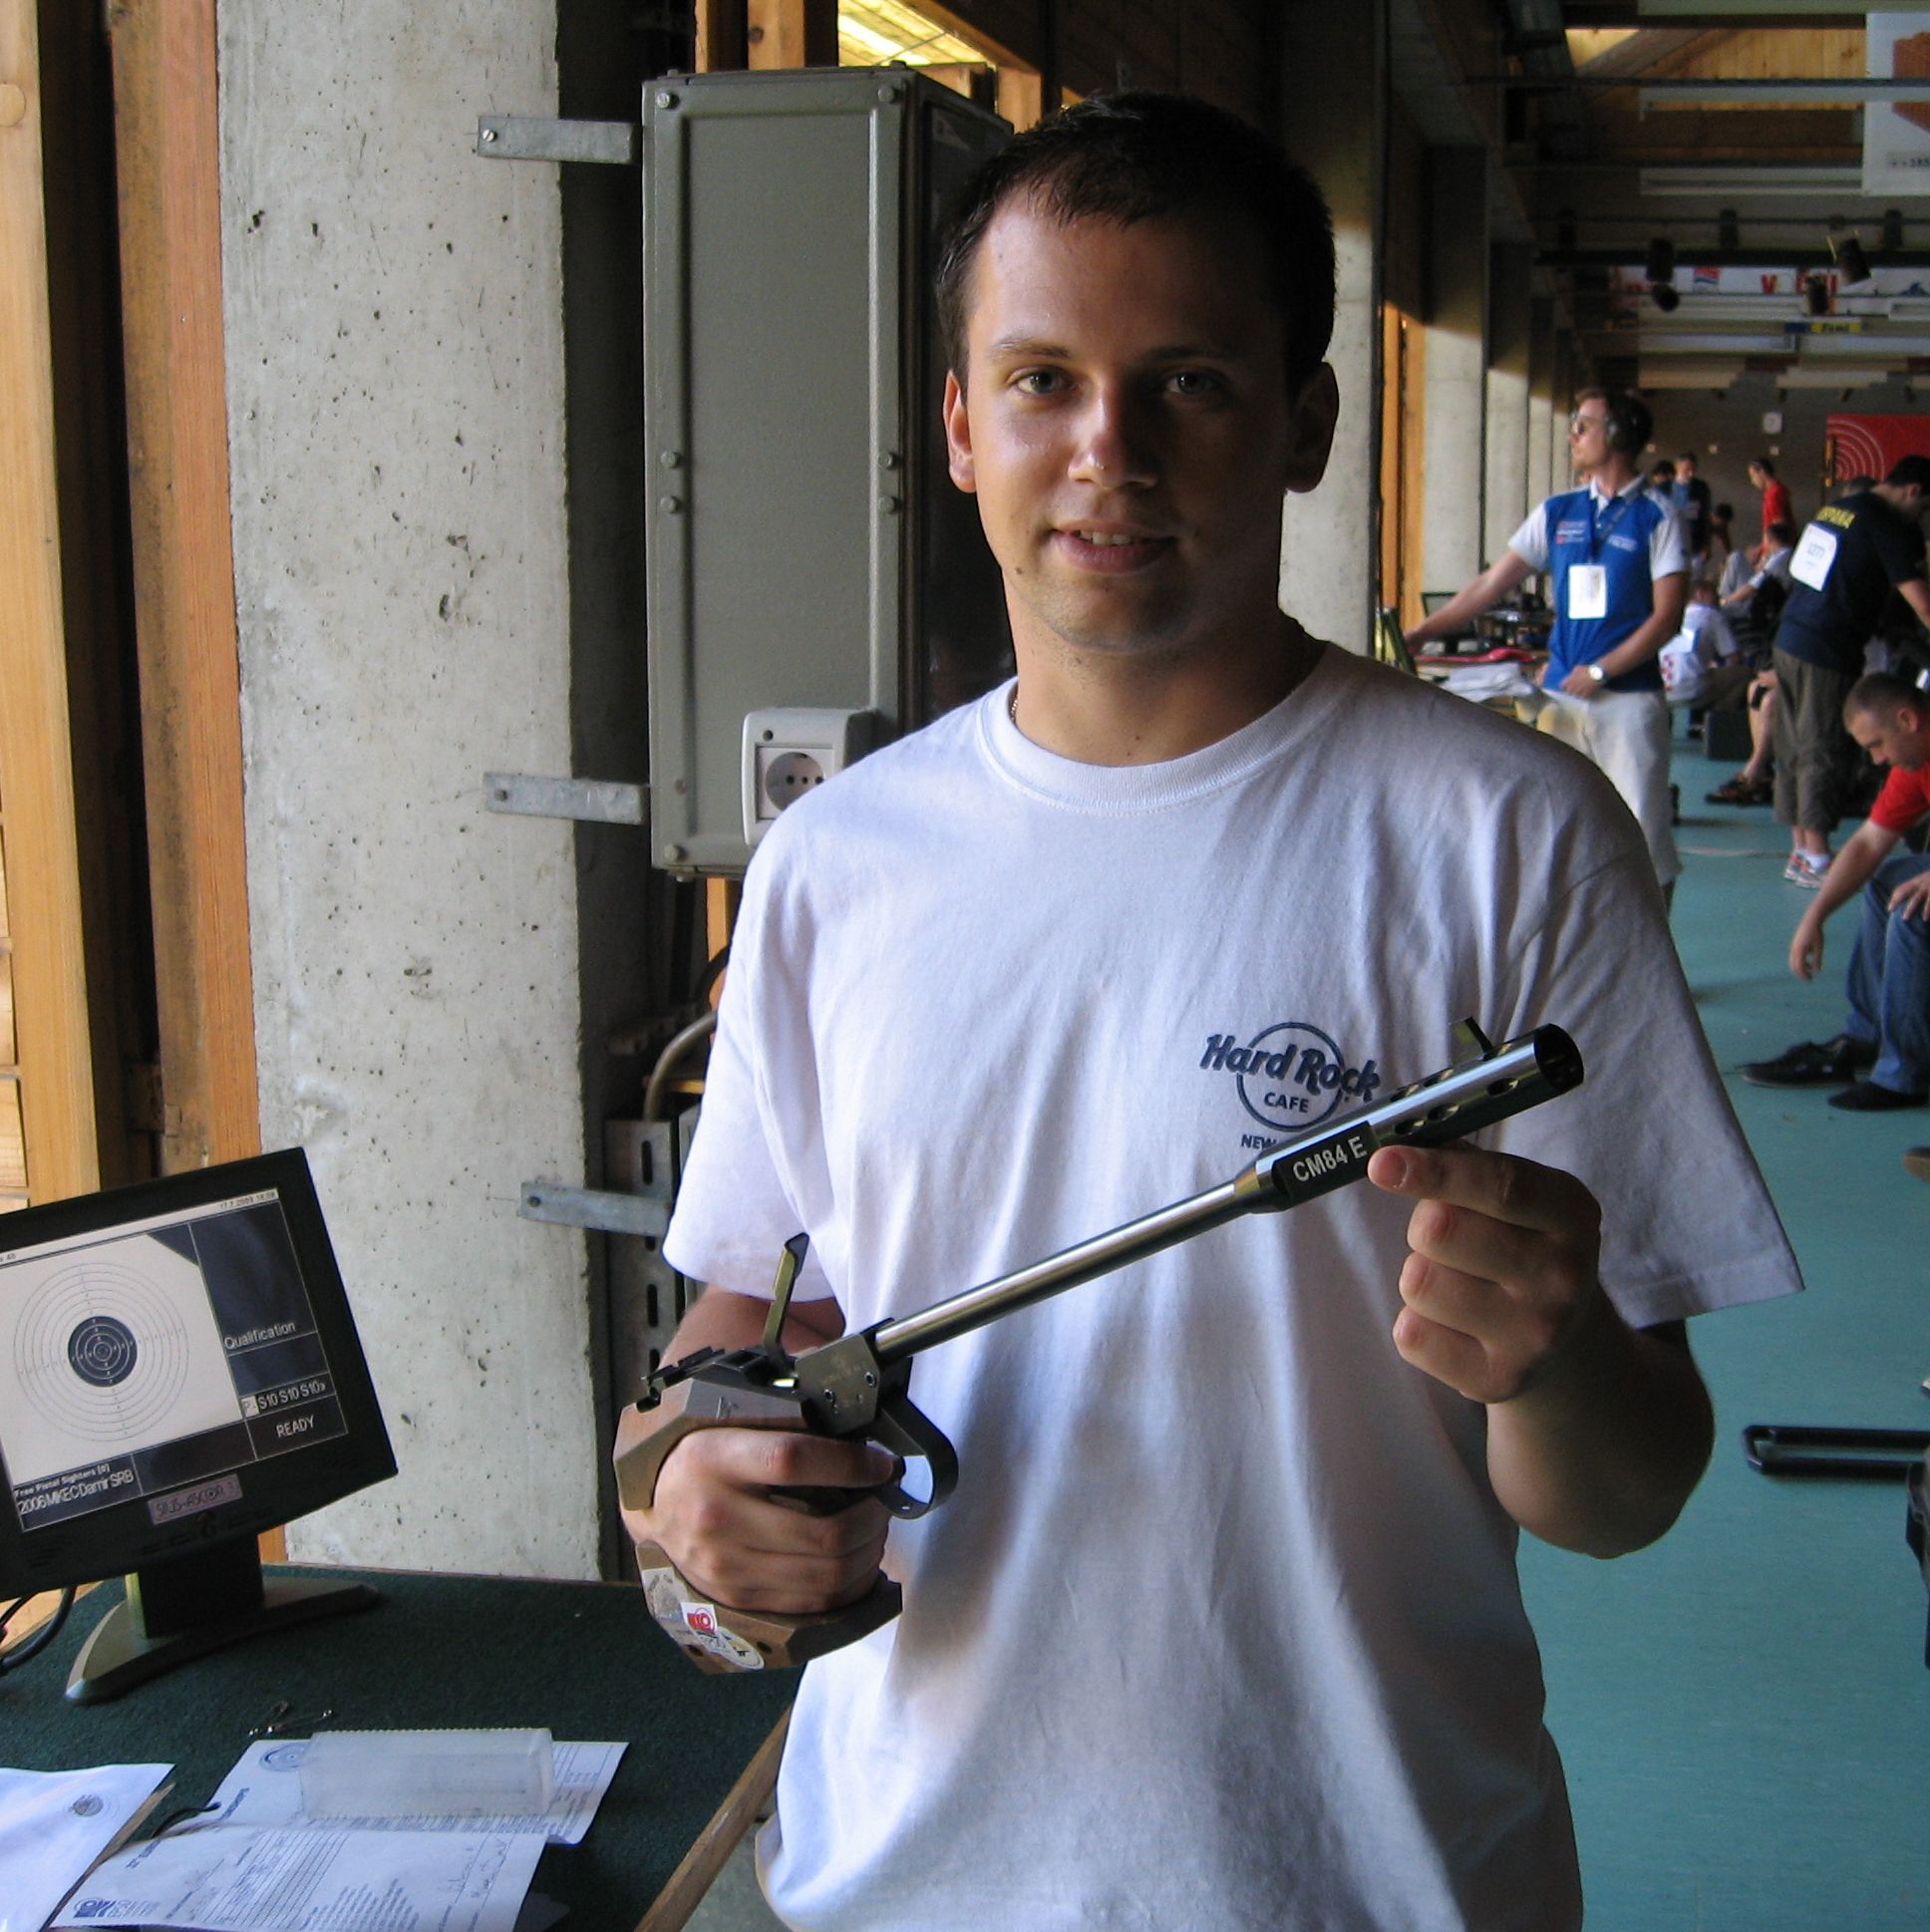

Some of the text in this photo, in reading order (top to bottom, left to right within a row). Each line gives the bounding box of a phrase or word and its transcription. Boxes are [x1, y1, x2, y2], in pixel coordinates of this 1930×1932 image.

[1199, 1034, 1382, 1104] Hard Rock
[1263, 1092, 1311, 1115] CAFE
[1292, 1135, 1368, 1183] CM84 E
[223, 1322, 297, 1350] Qualification
[257, 1394, 279, 1411] S10
[278, 1388, 300, 1405] S10
[275, 1414, 316, 1440] READY
[60, 1467, 98, 1486] Sighters
[18, 1494, 49, 1515] 2006
[79, 1476, 110, 1499] Damir
[109, 1468, 136, 1489] SRB
